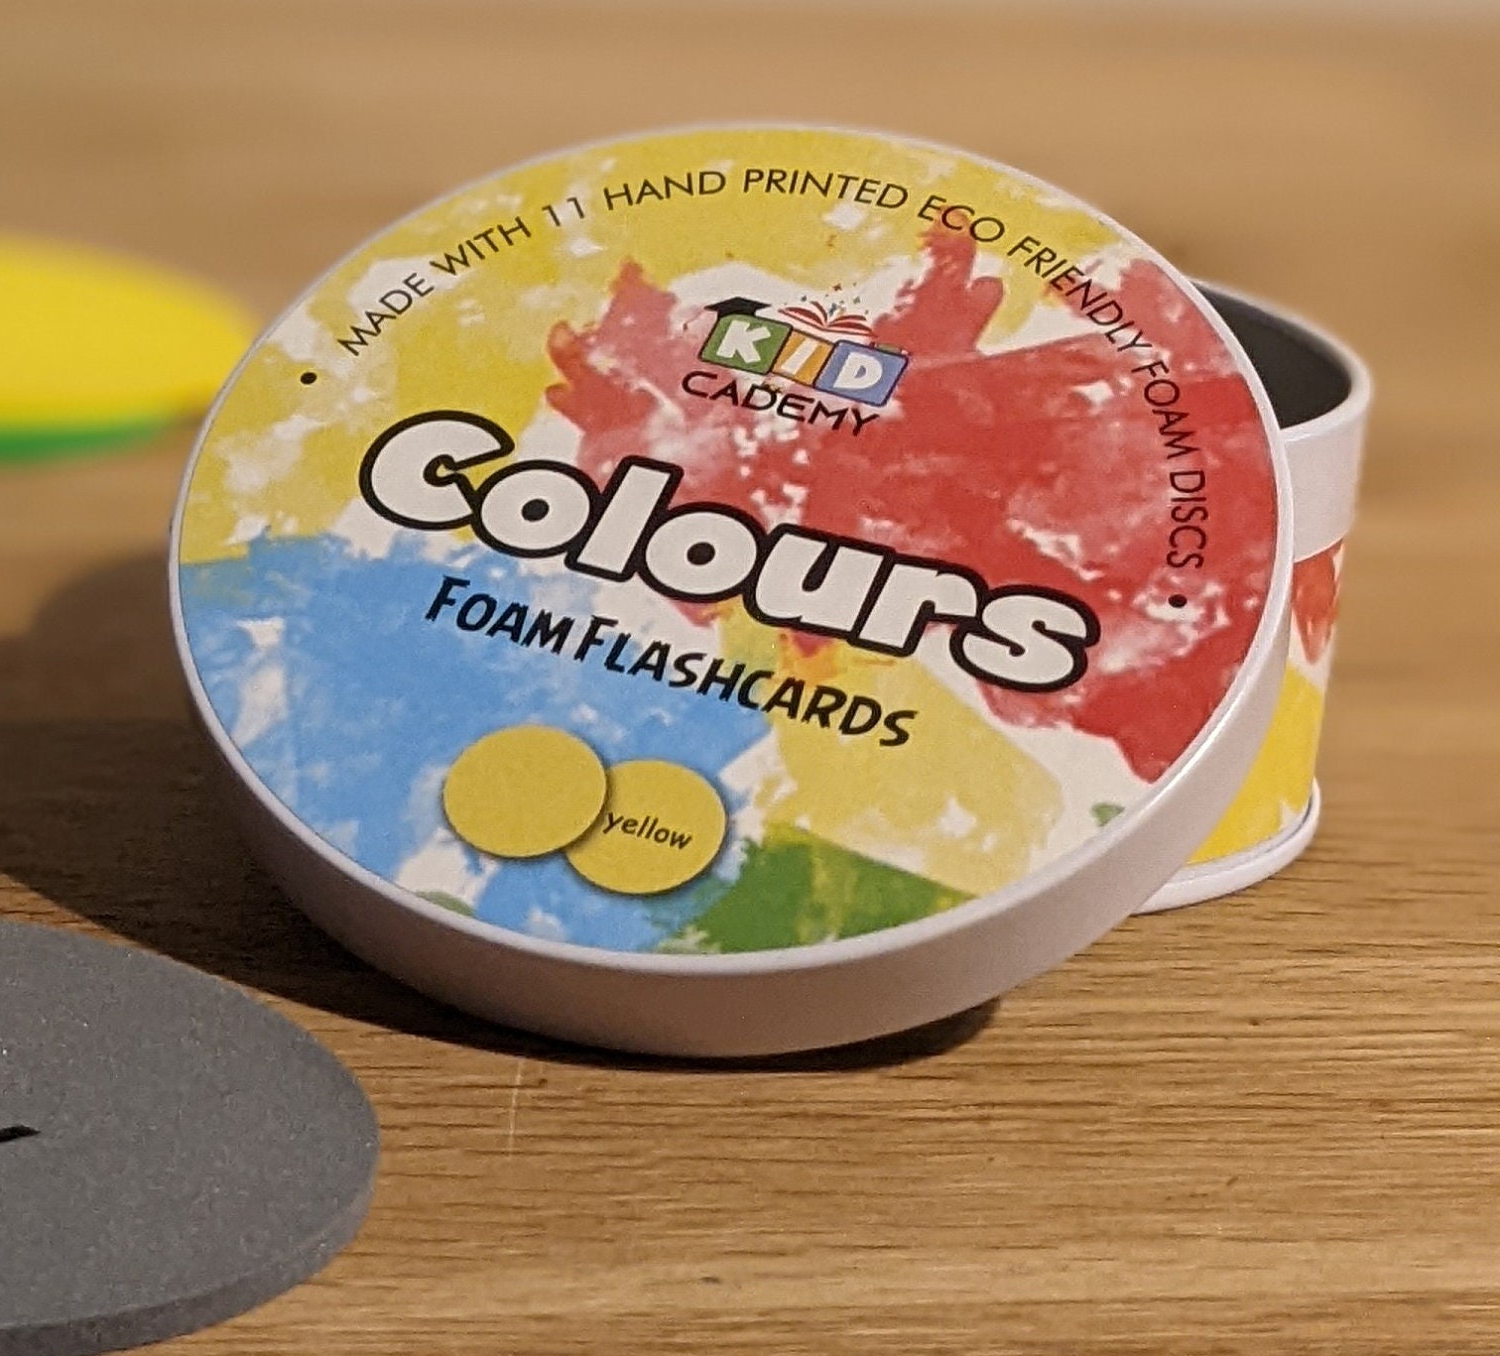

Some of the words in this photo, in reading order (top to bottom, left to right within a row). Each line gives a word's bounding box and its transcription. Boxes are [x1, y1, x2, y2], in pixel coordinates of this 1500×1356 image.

[337, 272, 434, 356] MADE
[430, 216, 531, 276] WITH
[541, 196, 587, 228] 11
[604, 170, 726, 211] HAND
[743, 168, 909, 209] PRINTED
[918, 194, 1005, 244] ECO
[1006, 235, 1152, 353] FRIENDLY
[1131, 358, 1198, 458] FOAM
[1169, 469, 1209, 570] DISCS
[682, 371, 880, 437] CADEMY
[716, 320, 883, 389] KID
[359, 410, 1101, 693] Colours
[424, 575, 576, 656] FOAM
[573, 614, 918, 748] FLASHCARDS
[603, 812, 693, 850] yellow
